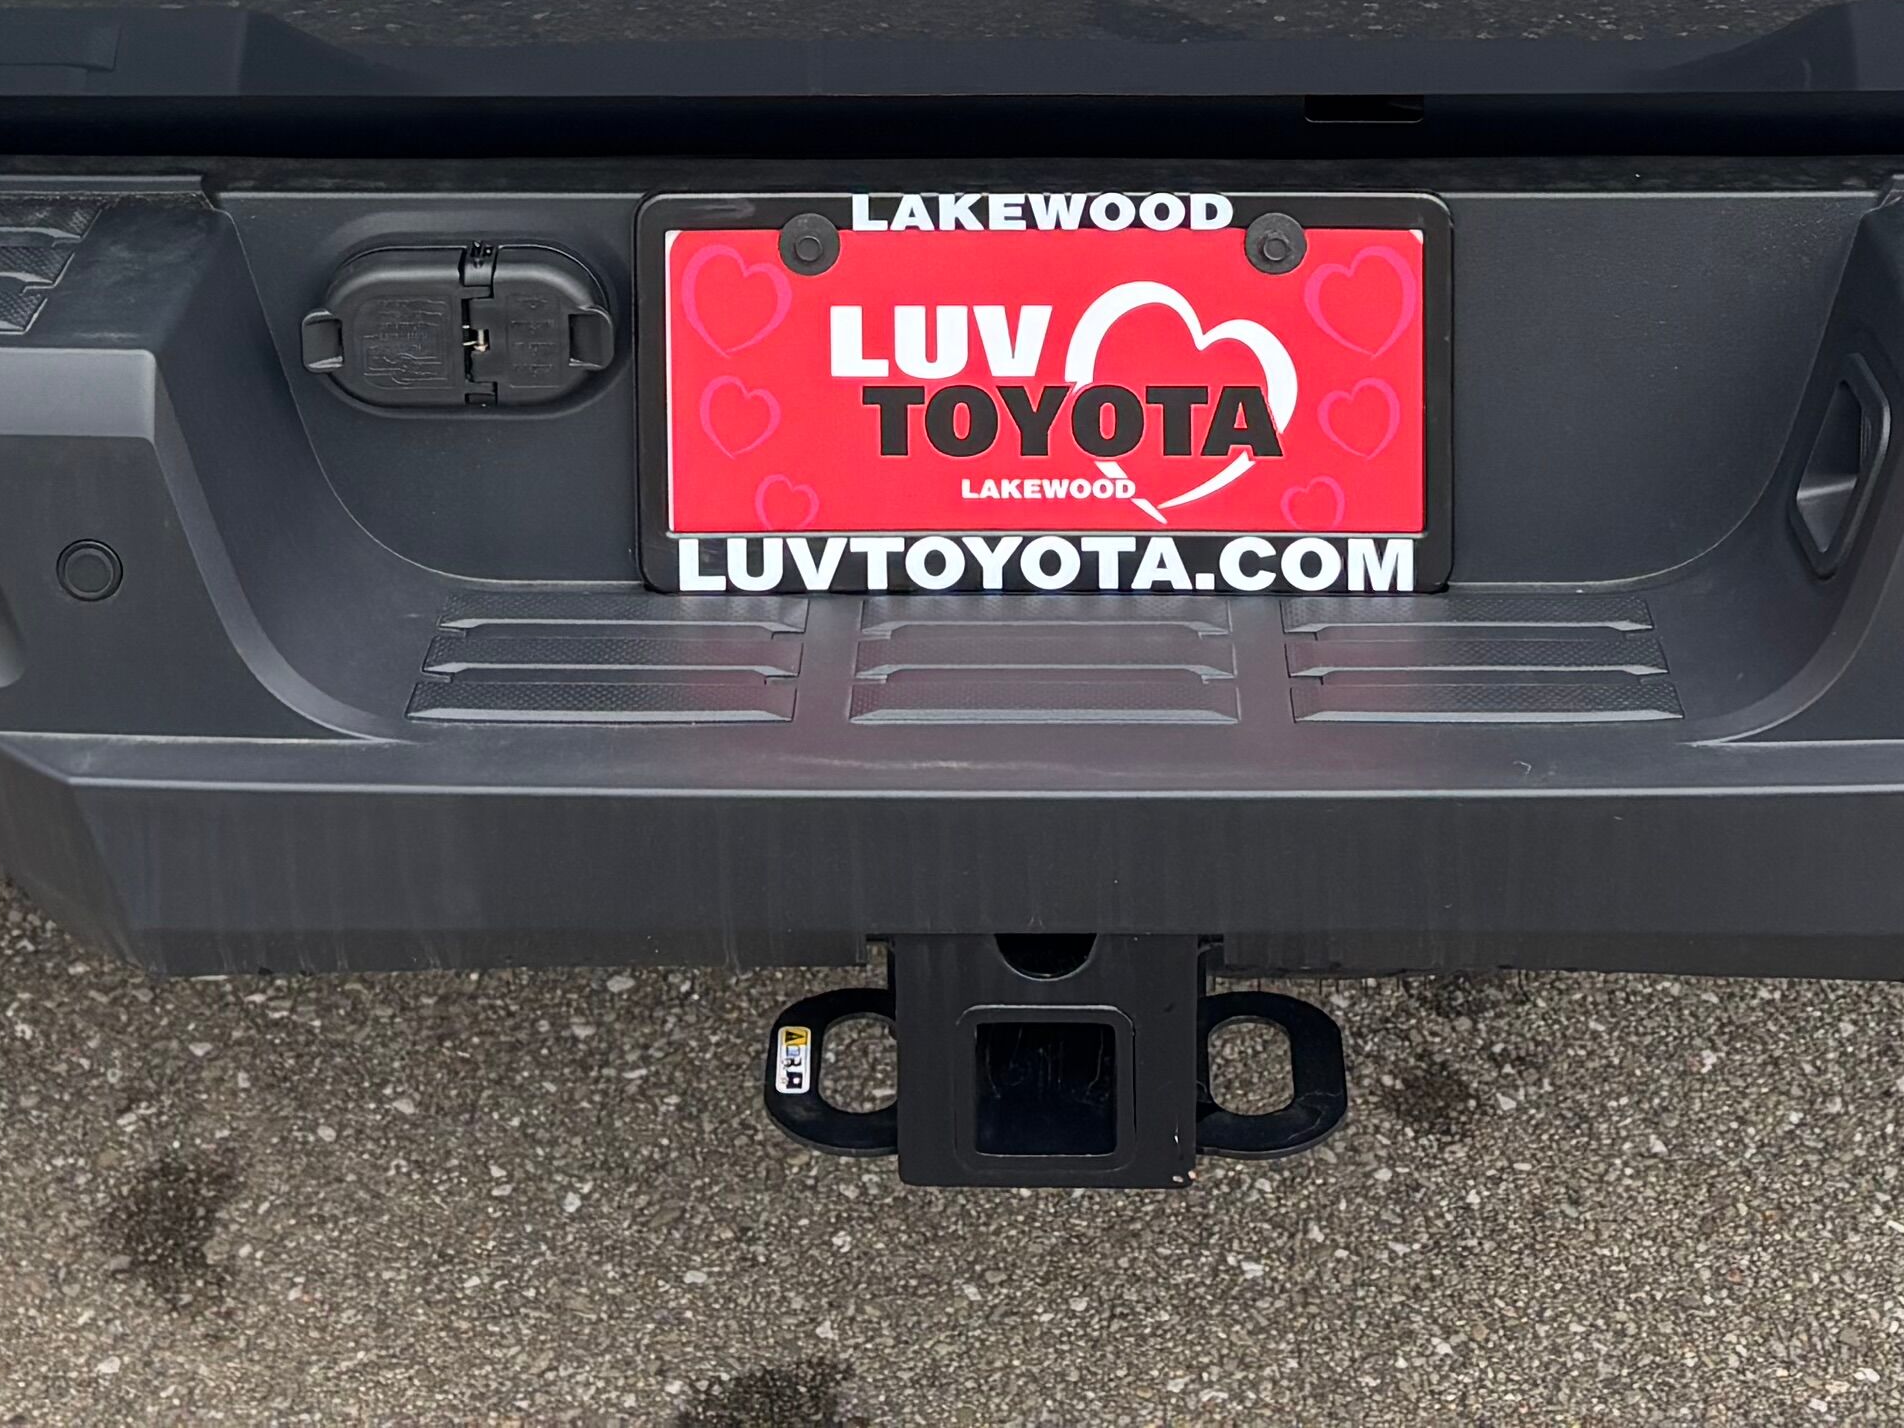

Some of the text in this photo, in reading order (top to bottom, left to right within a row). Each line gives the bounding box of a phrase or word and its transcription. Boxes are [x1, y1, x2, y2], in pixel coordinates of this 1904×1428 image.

[852, 192, 1234, 232] LAKEWOOD
[829, 304, 1053, 379] LUV
[862, 384, 1283, 459] TOYOTA
[960, 477, 1137, 500] LAKEWOOD
[678, 536, 1415, 593] LUVTOYOTA.COM
